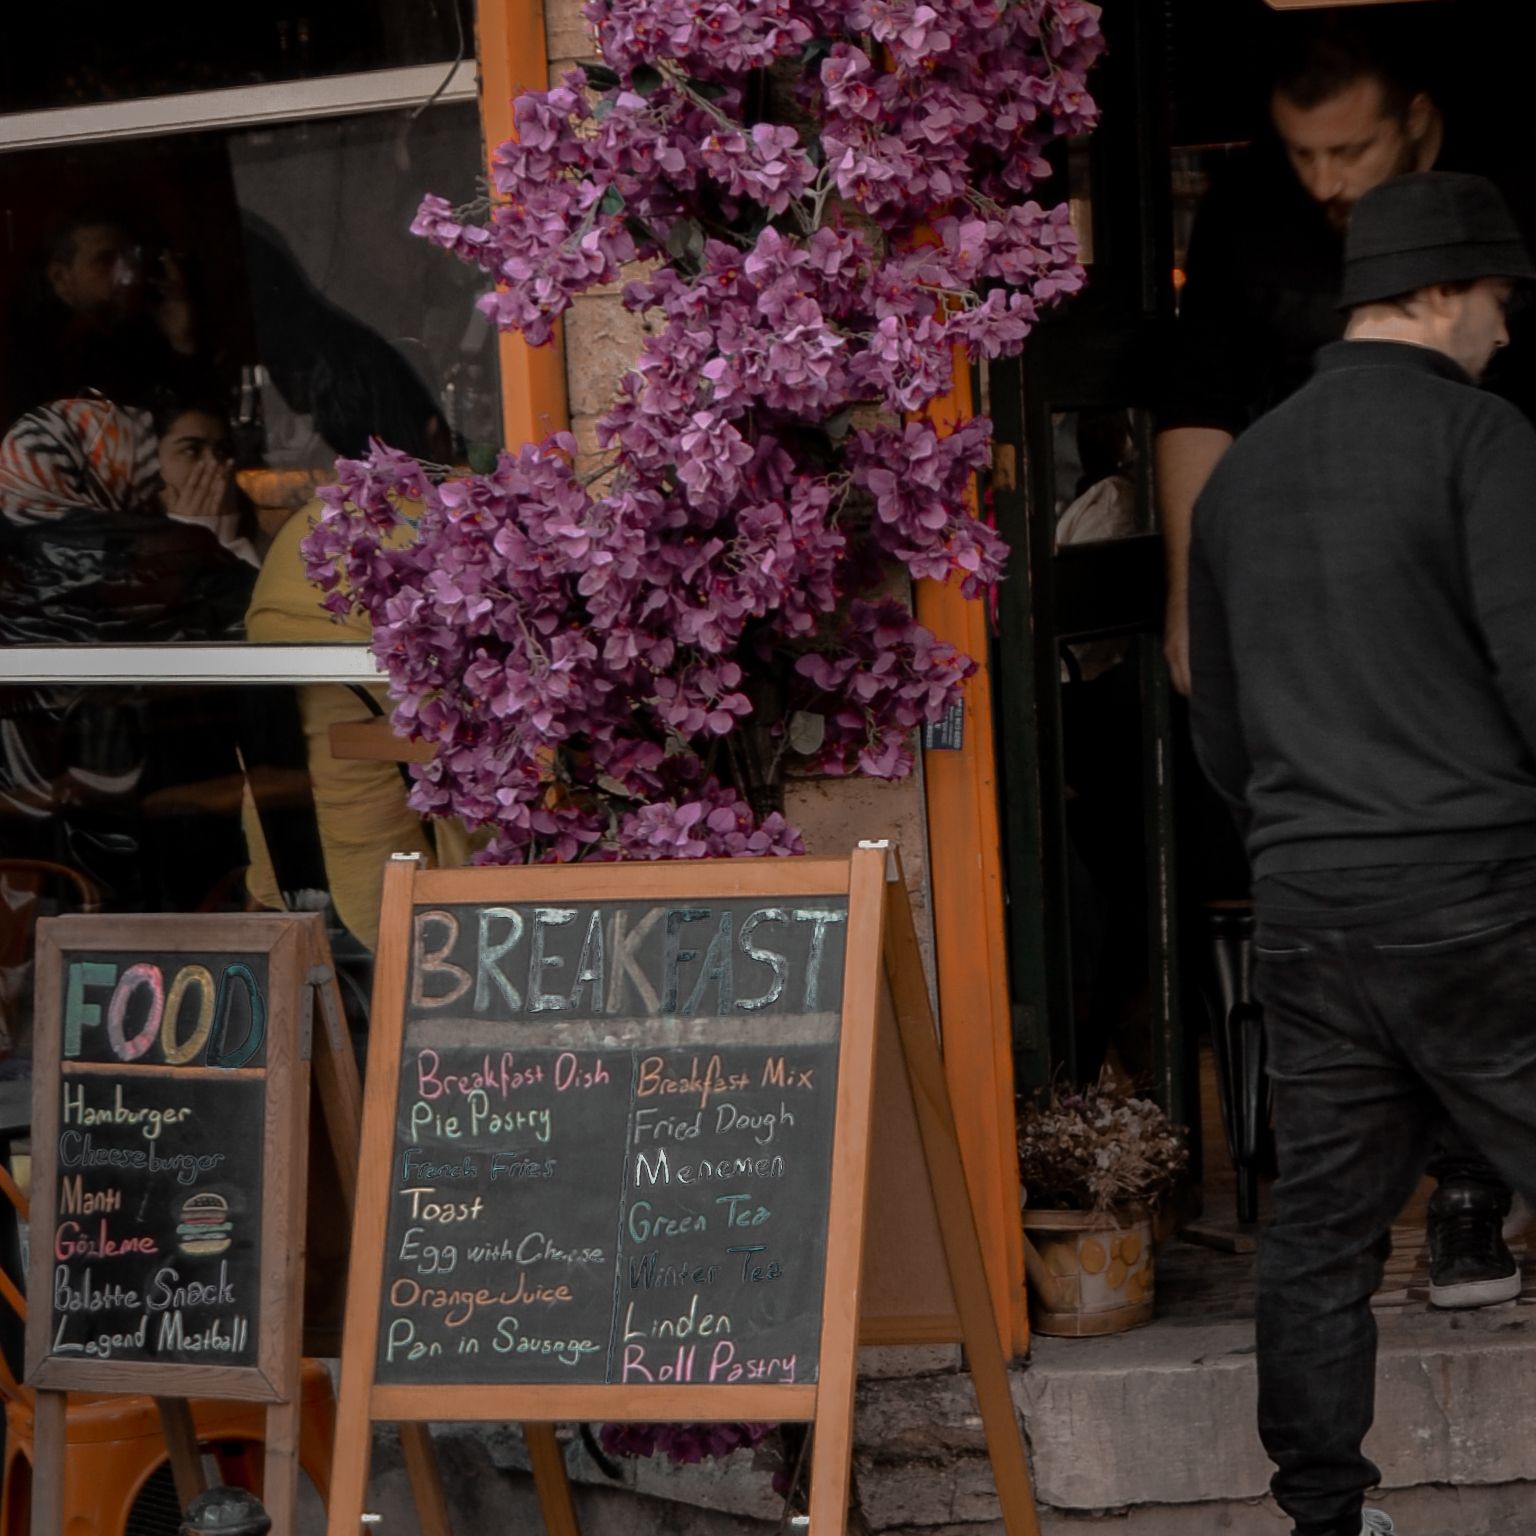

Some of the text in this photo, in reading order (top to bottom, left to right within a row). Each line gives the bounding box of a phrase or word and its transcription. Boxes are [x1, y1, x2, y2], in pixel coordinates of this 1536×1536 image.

[411, 908, 847, 1014] BREAKFAST
[64, 962, 266, 1068] FOOD
[418, 1049, 610, 1100] Breakfast Dish
[637, 1055, 813, 1109] Breakfast Mix
[64, 1081, 192, 1139] Hamburger
[411, 1089, 550, 1143] Pie Pastry
[634, 1101, 794, 1144] Fried Dough
[60, 1130, 225, 1185] Cheeseburger
[490, 1152, 557, 1181] Fries
[634, 1147, 785, 1188] Menemen
[400, 1188, 484, 1223] Toast
[628, 1194, 772, 1243] Green Tea
[54, 1218, 159, 1261] Gözleme
[399, 1228, 458, 1274] Egg
[467, 1239, 513, 1262] with
[54, 1259, 236, 1312] Balatte Snack
[629, 1245, 782, 1289] Winter Tea
[390, 1272, 573, 1327] Orange Juice
[624, 1294, 731, 1342] Linden
[157, 1309, 248, 1352] Meatball
[386, 1318, 442, 1362] Pan
[458, 1337, 479, 1353] in
[623, 1341, 797, 1383] Roll Pastry
